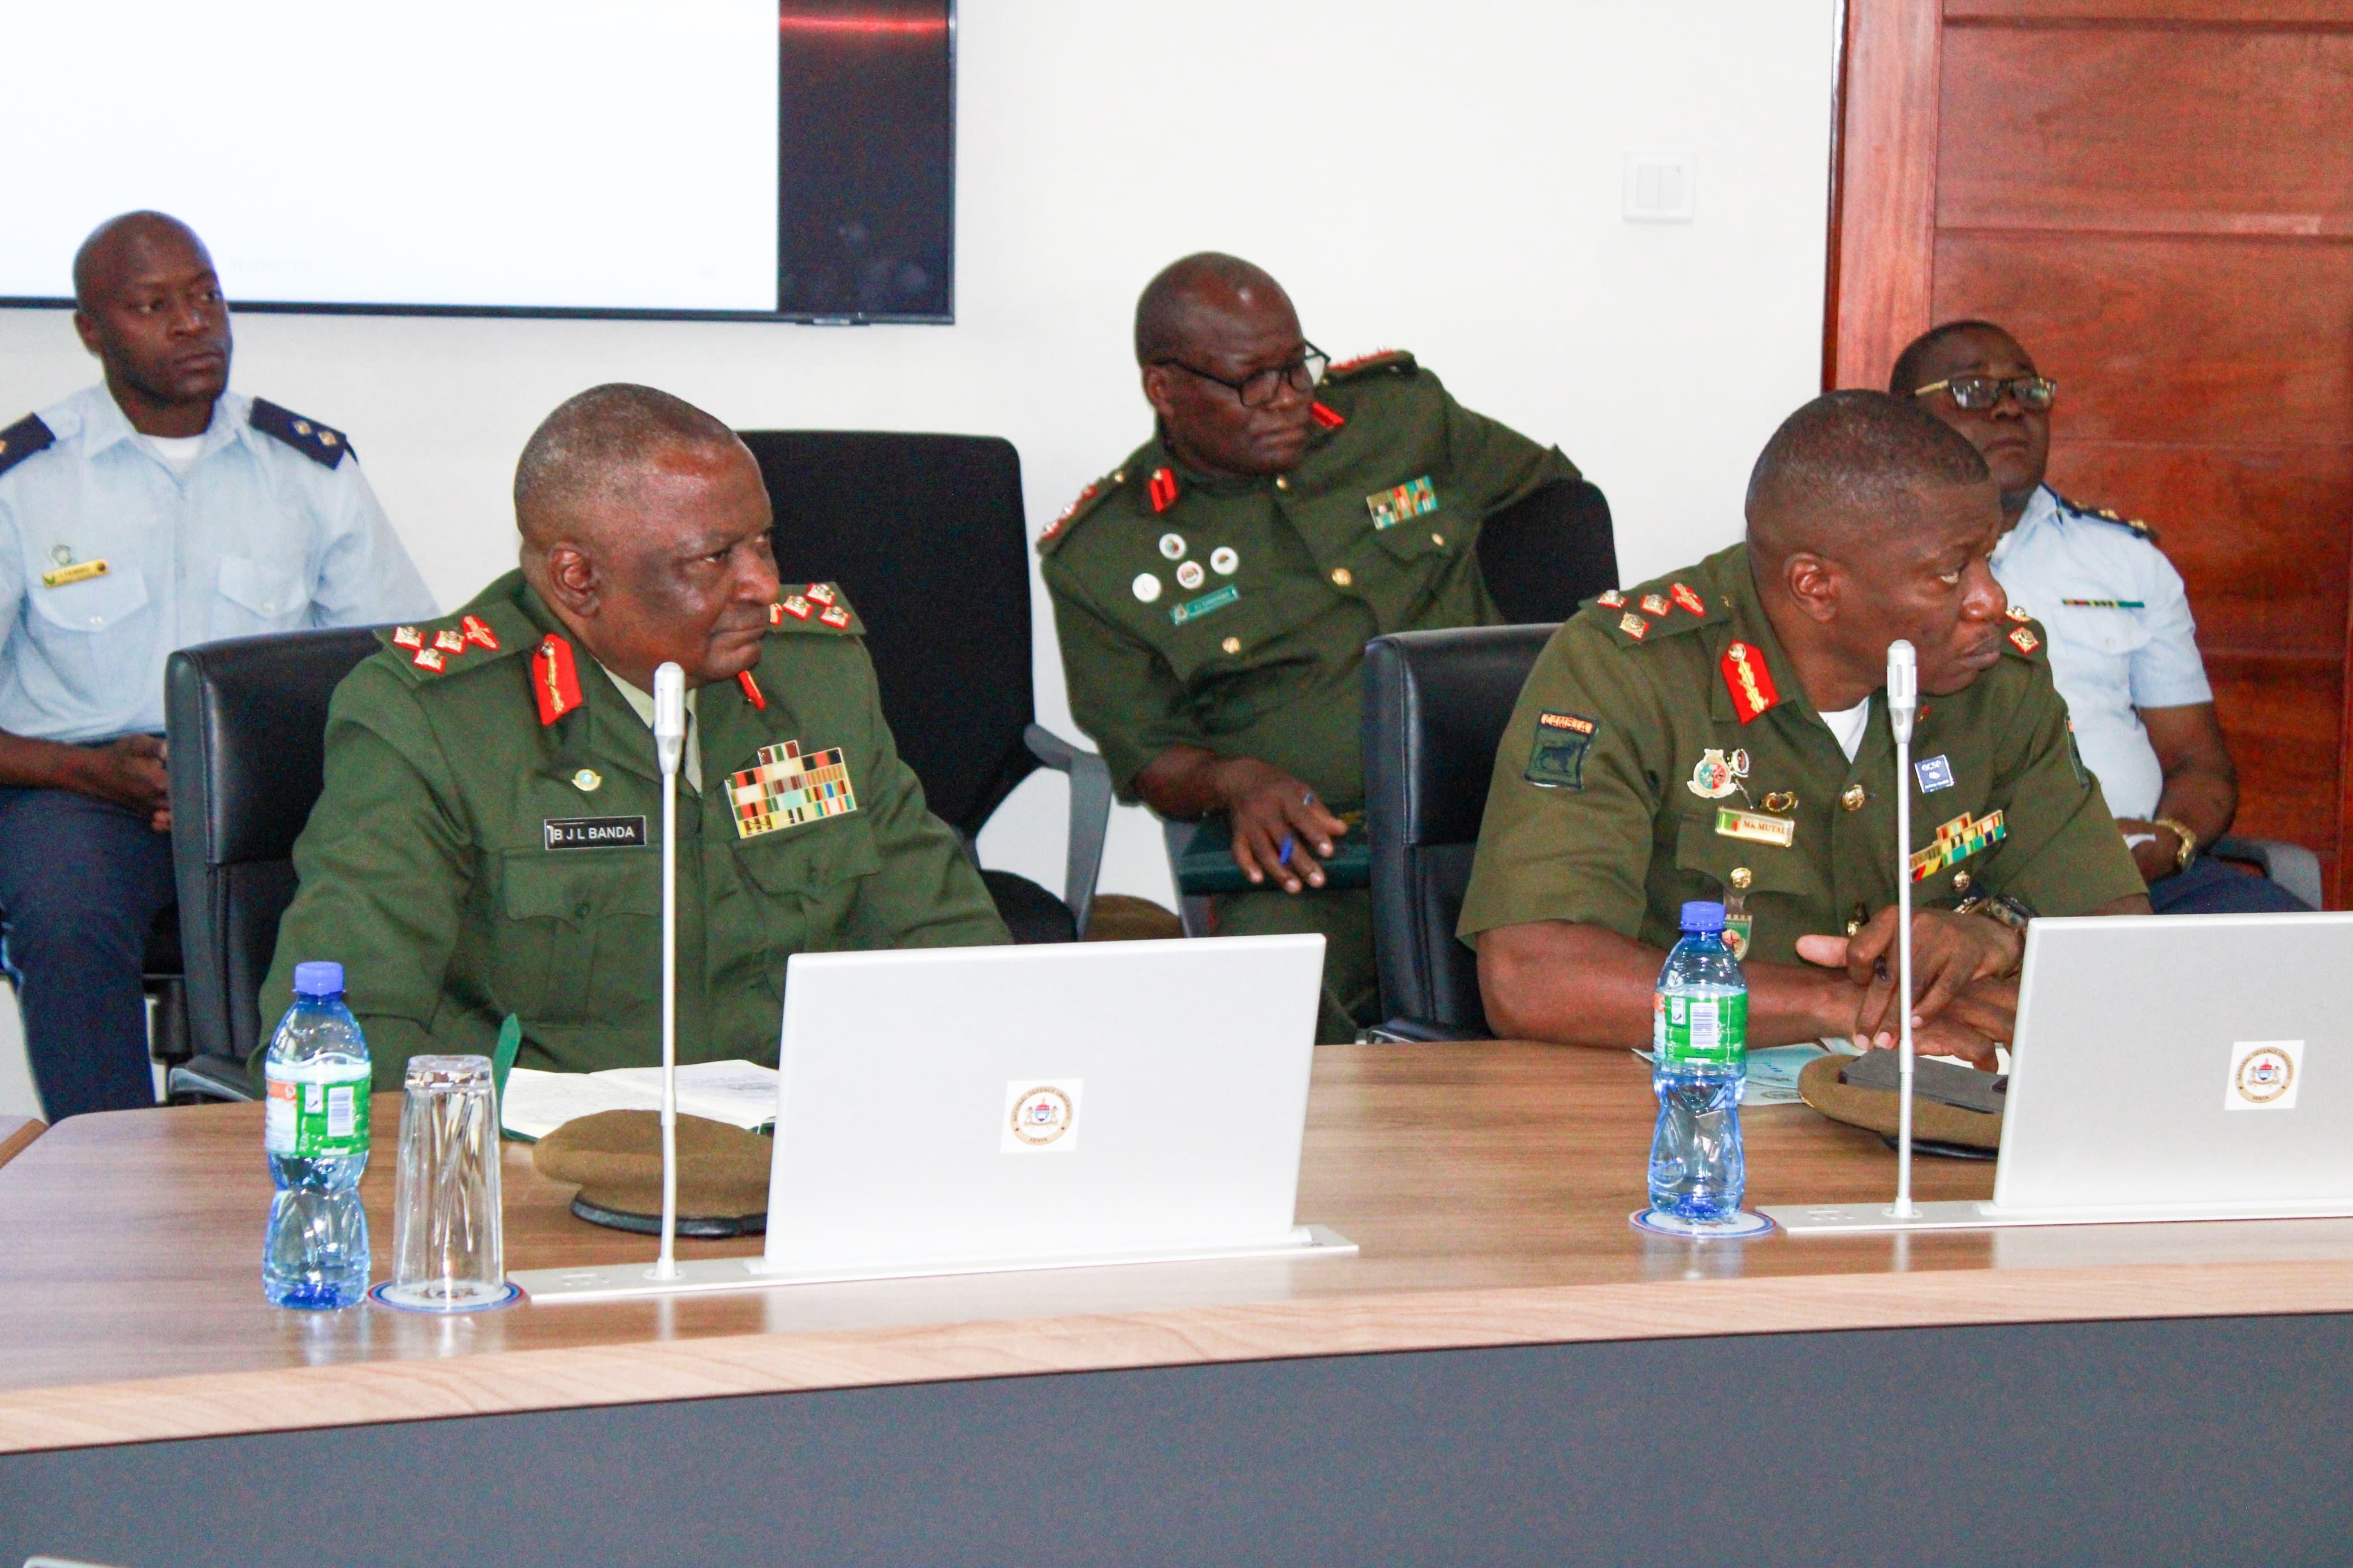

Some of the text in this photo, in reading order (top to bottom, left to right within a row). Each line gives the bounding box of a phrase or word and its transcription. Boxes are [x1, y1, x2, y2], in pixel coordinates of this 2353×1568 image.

[554, 826, 635, 841] B J L BANDA
